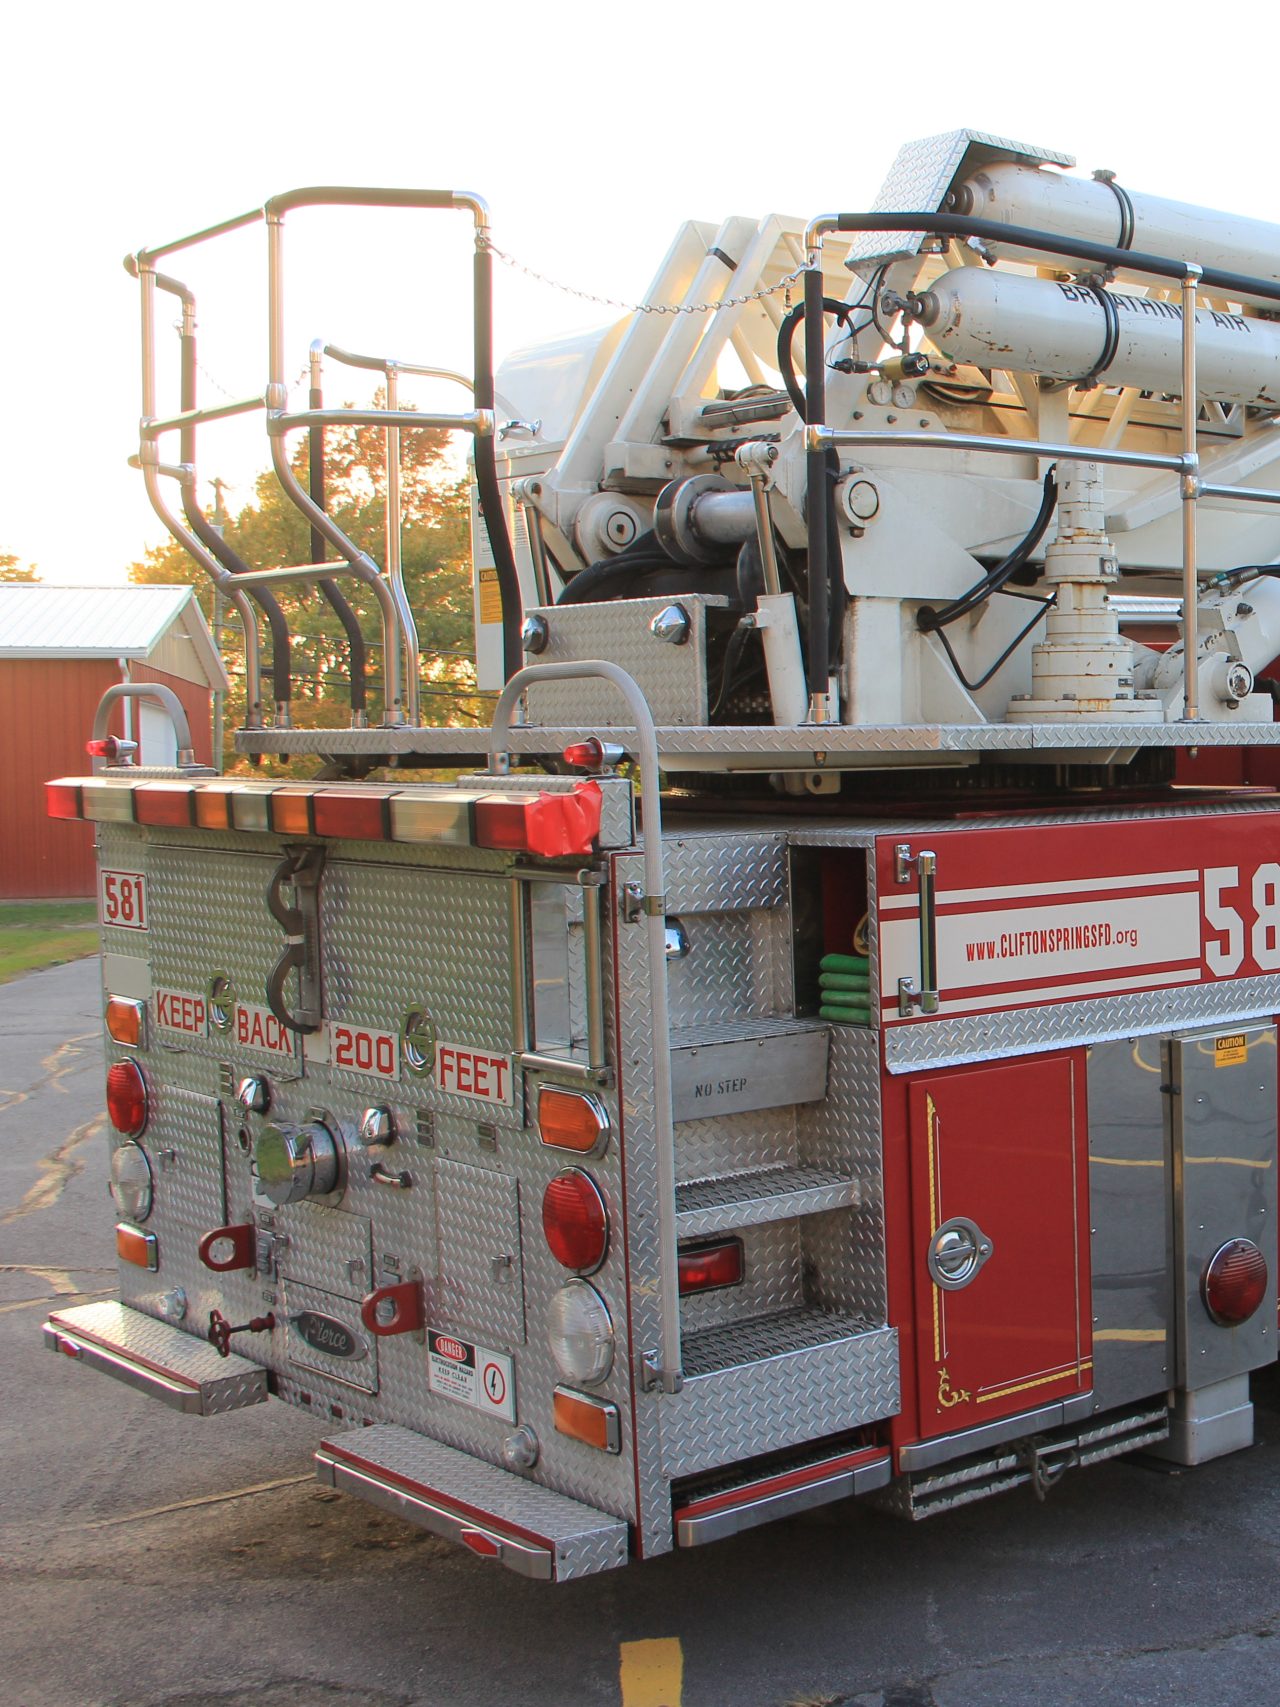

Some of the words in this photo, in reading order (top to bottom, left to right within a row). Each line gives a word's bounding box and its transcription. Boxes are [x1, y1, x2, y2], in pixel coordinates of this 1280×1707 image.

[1056, 283, 1200, 324] BRATHIN
[1210, 311, 1250, 332] AIR
[105, 876, 145, 923] 581
[157, 991, 205, 1033] KEEP
[238, 1007, 292, 1053] BACK
[336, 1028, 394, 1074] 200
[440, 1049, 508, 1099] FEET
[1217, 1036, 1244, 1050] CAUTION
[695, 1083, 712, 1098] NO
[717, 1078, 747, 1095] STEP
[304, 1316, 348, 1350] Pierce
[440, 1338, 463, 1360] DANGER
[438, 1367, 450, 1376] KEEP
[451, 1372, 468, 1383] CLEAR
